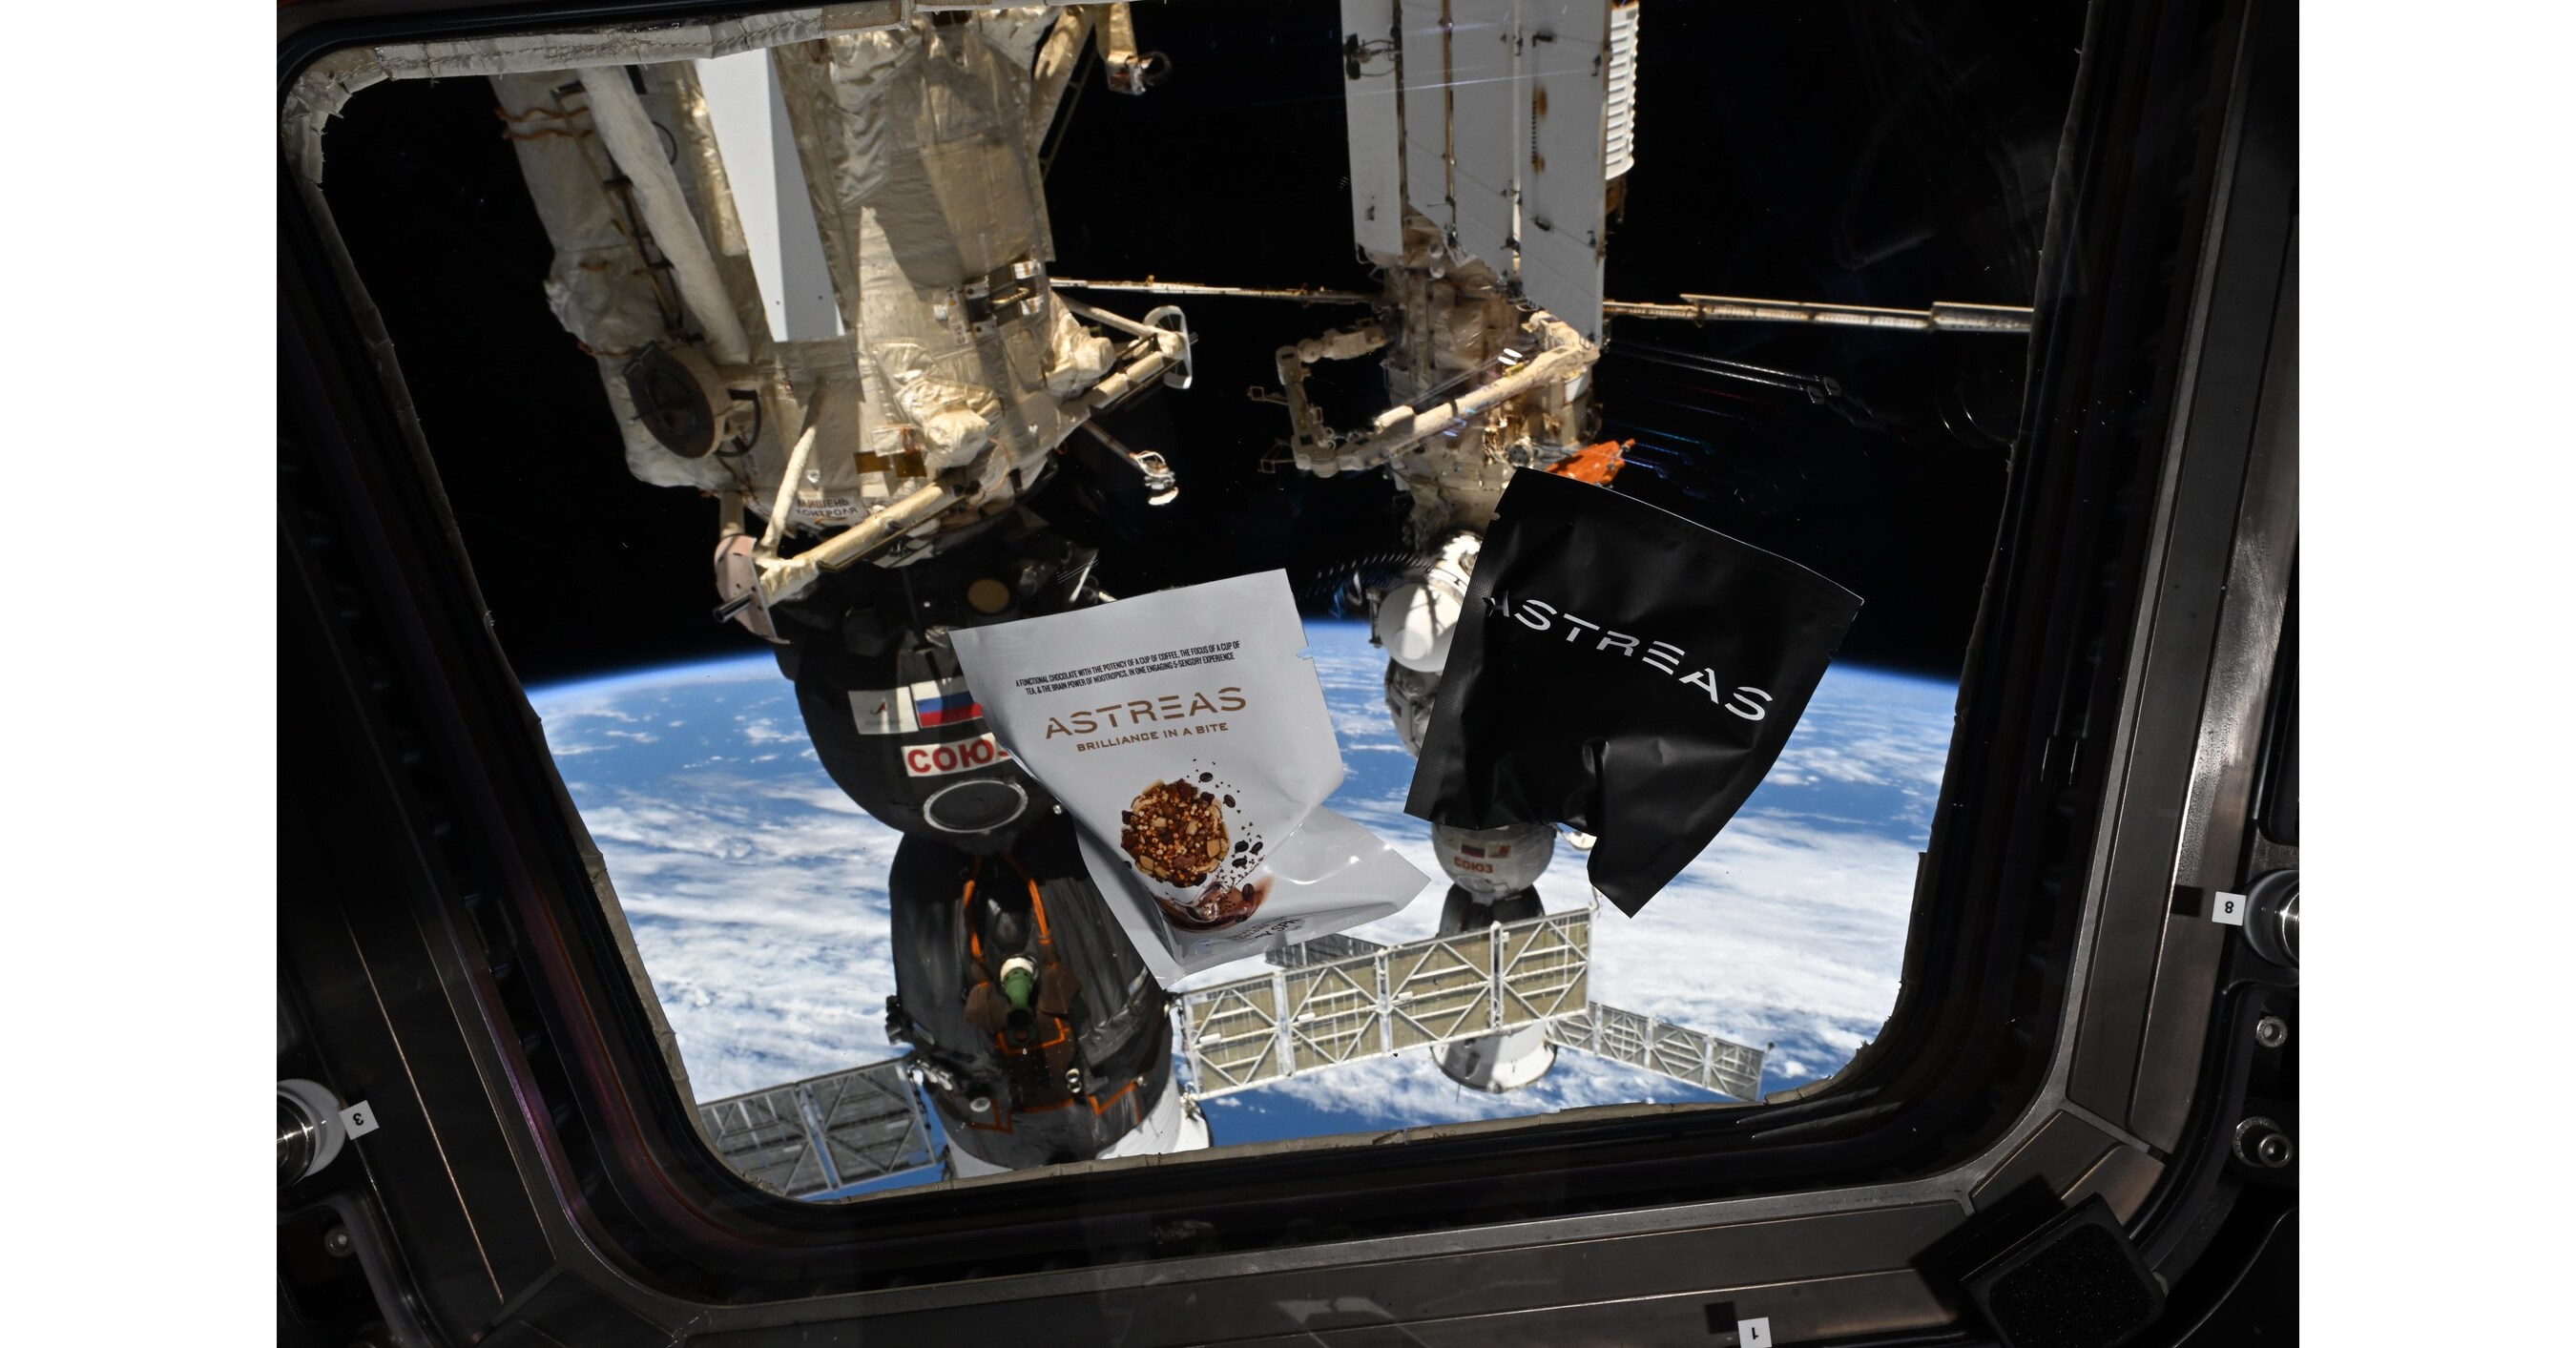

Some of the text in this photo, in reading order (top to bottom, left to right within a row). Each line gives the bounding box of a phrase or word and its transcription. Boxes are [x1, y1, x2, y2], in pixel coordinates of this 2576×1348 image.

[1020, 675, 1049, 687] FUNCTIONAL
[1049, 671, 1078, 683] CHOCOLATE
[1077, 668, 1092, 677] WITH
[1091, 665, 1103, 674] THE
[1103, 660, 1128, 673] POTENCY
[1127, 658, 1134, 667] OF
[1139, 656, 1151, 665] CUP
[1179, 649, 1191, 657] THE
[1191, 646, 1209, 655] FOCUS
[1209, 644, 1215, 653] OF
[1220, 642, 1232, 651] CUP
[1233, 640, 1240, 649] OF
[1487, 590, 1774, 721] ASTREAS
[1042, 685, 1051, 694] THE
[1051, 682, 1068, 692] BRAIN
[1068, 678, 1087, 689] POWER
[1129, 668, 1135, 676] IN
[1135, 666, 1147, 674] ONE
[1147, 661, 1174, 673] ENGAGING
[1173, 656, 1202, 669] 5-SENSORY
[1202, 652, 1235, 664] EXPERIENCE
[1046, 686, 1247, 739] ASTREAS
[1076, 722, 1229, 752] BRILLIANCE IN A BITE
[907, 738, 1009, 774] СОЮ
[1453, 856, 1494, 874] СОЮЗ
[2224, 901, 2234, 914] 8
[352, 1112, 364, 1126] 3
[1752, 1327, 1758, 1340] 1
